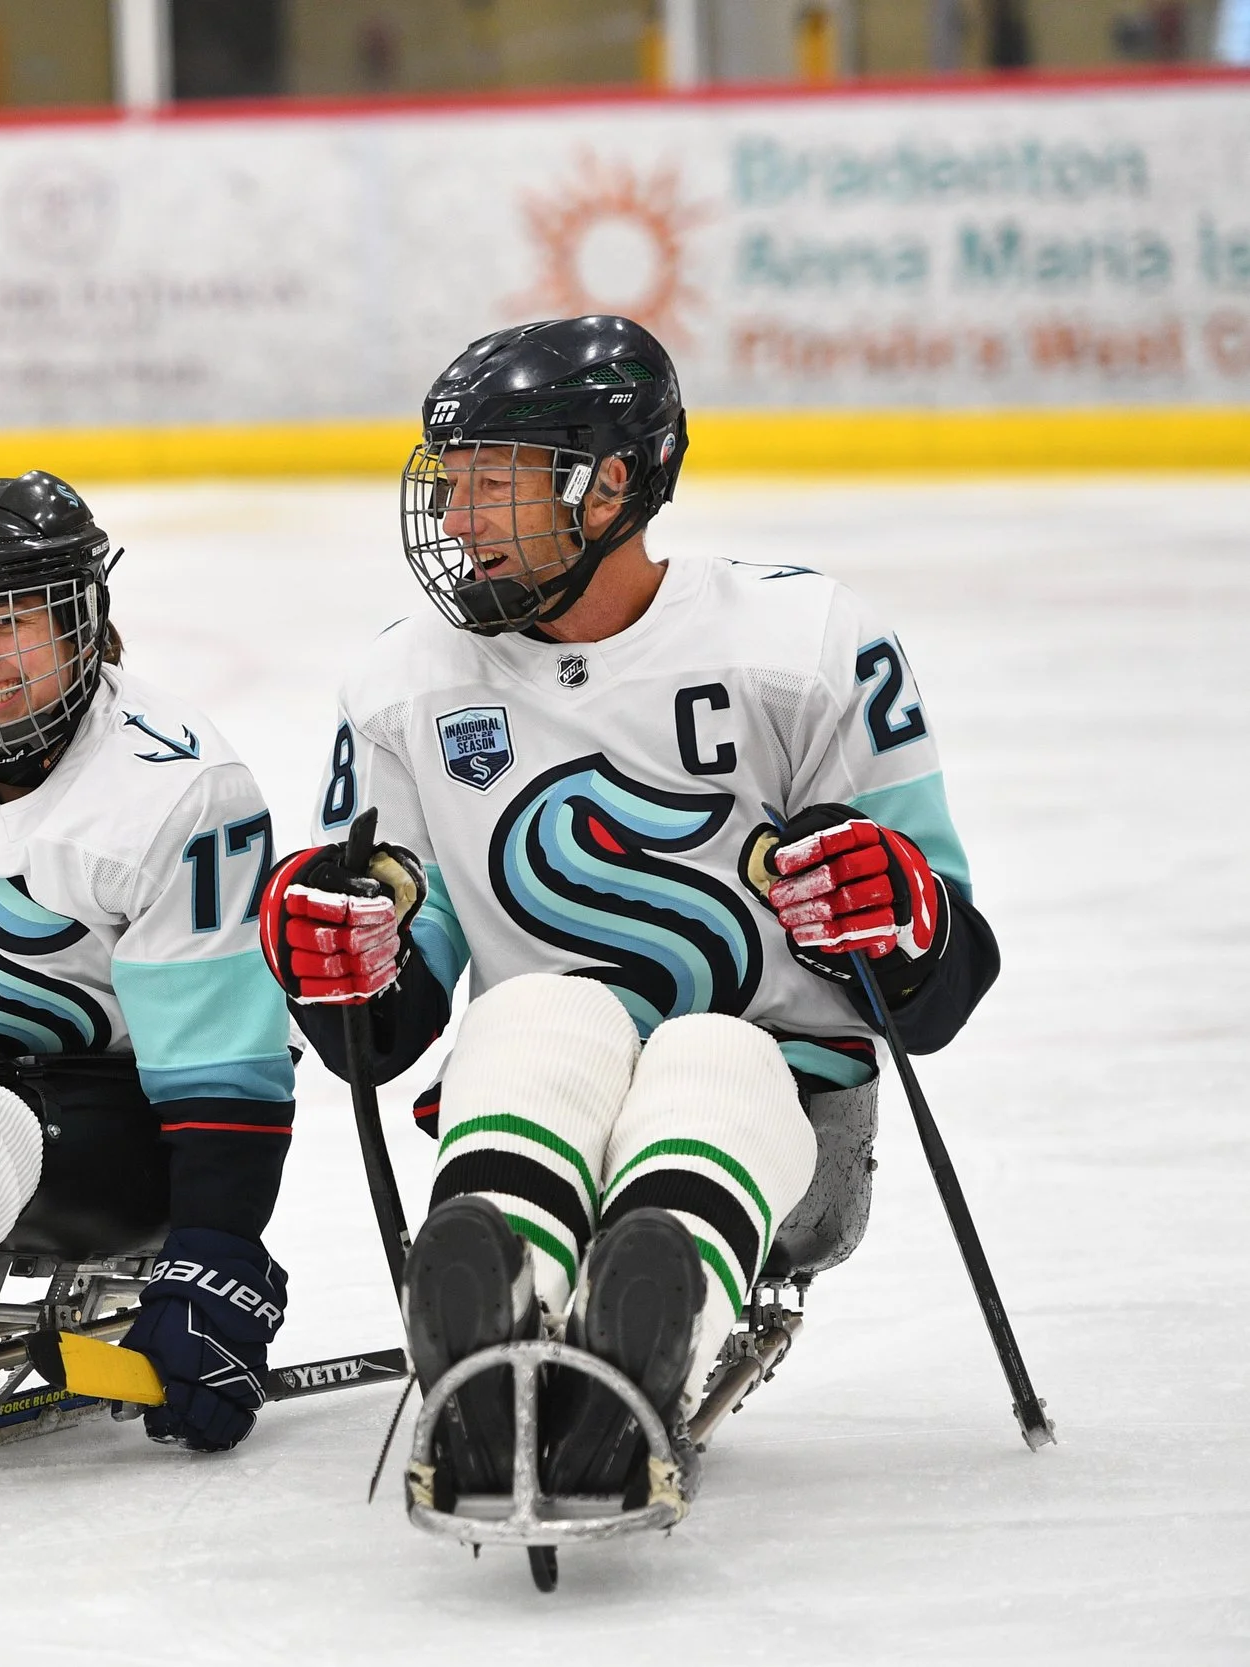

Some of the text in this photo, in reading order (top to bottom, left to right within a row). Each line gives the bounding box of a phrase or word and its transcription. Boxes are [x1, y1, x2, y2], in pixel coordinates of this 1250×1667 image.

[958, 212, 1172, 286] Maria
[855, 630, 928, 756] 2
[445, 717, 502, 739] INAUGURAL
[456, 730, 494, 743] 2021-22
[457, 737, 497, 754] SEASON
[674, 682, 738, 776] C
[321, 718, 358, 831] 8
[182, 807, 274, 934] 17
[148, 1260, 282, 1329] BAUER
[0, 1400, 31, 1415] FORCE
[33, 1390, 66, 1407] BLADE
[292, 1359, 360, 1389] YETTI
